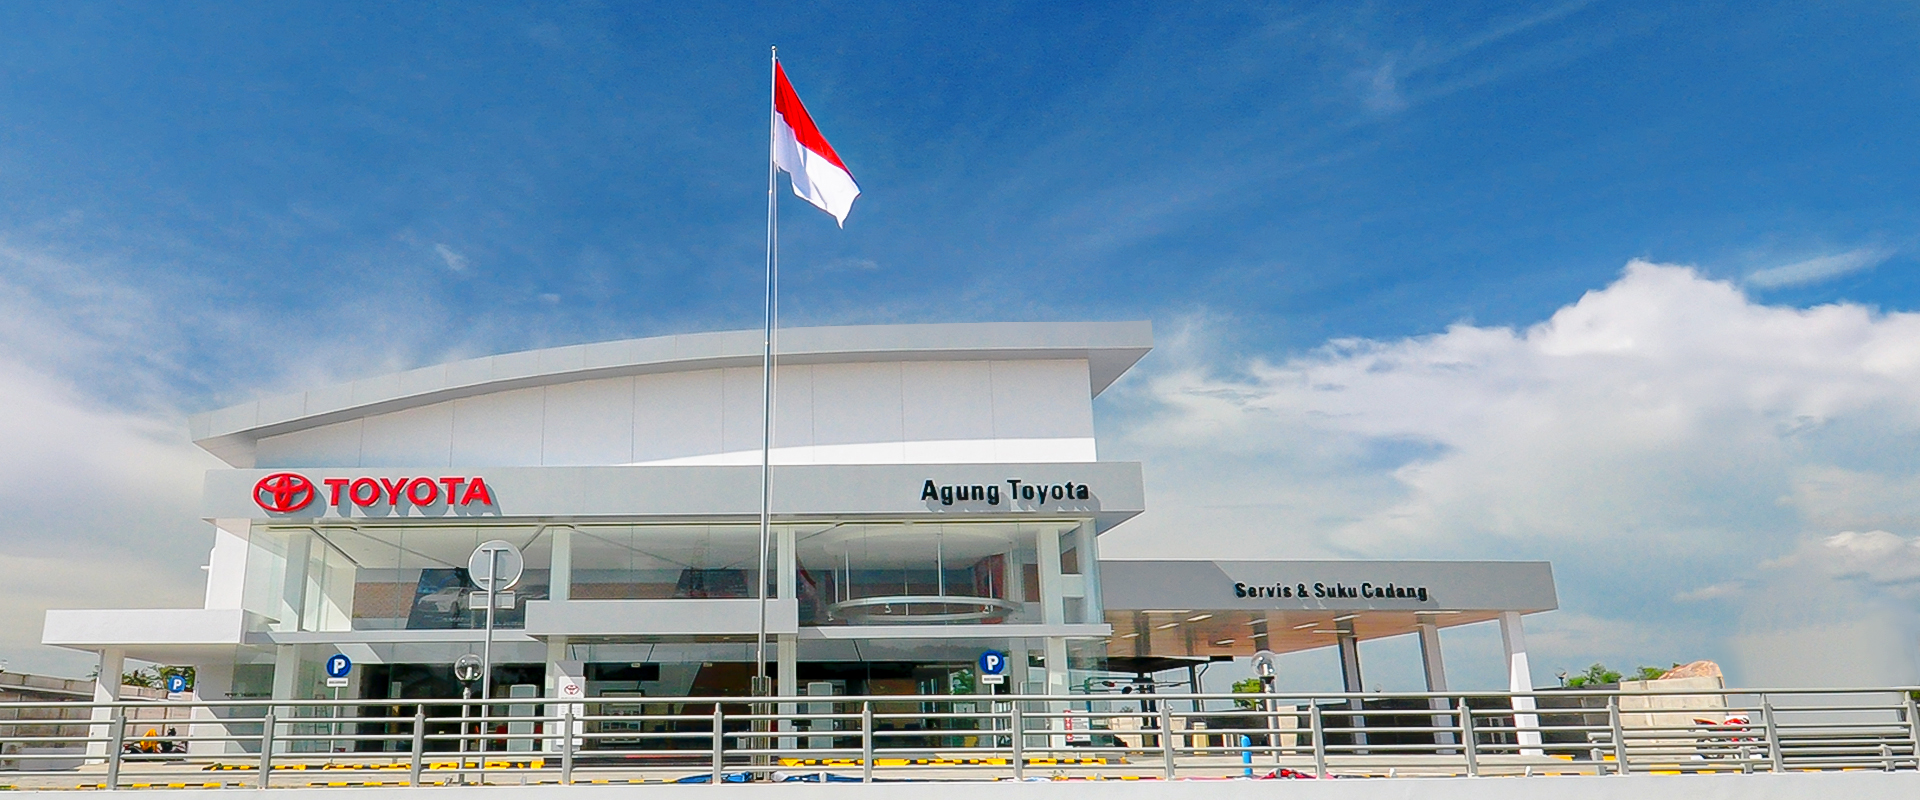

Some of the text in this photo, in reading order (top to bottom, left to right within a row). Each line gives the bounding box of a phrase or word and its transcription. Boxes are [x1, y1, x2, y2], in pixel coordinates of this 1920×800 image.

[323, 477, 493, 507] TOYOTA
[921, 479, 1090, 506] Agung Toyota
[1234, 582, 1428, 602] Servis & Suku Cadang
[333, 658, 346, 674] P
[987, 655, 1000, 671] P
[172, 678, 182, 690] P
